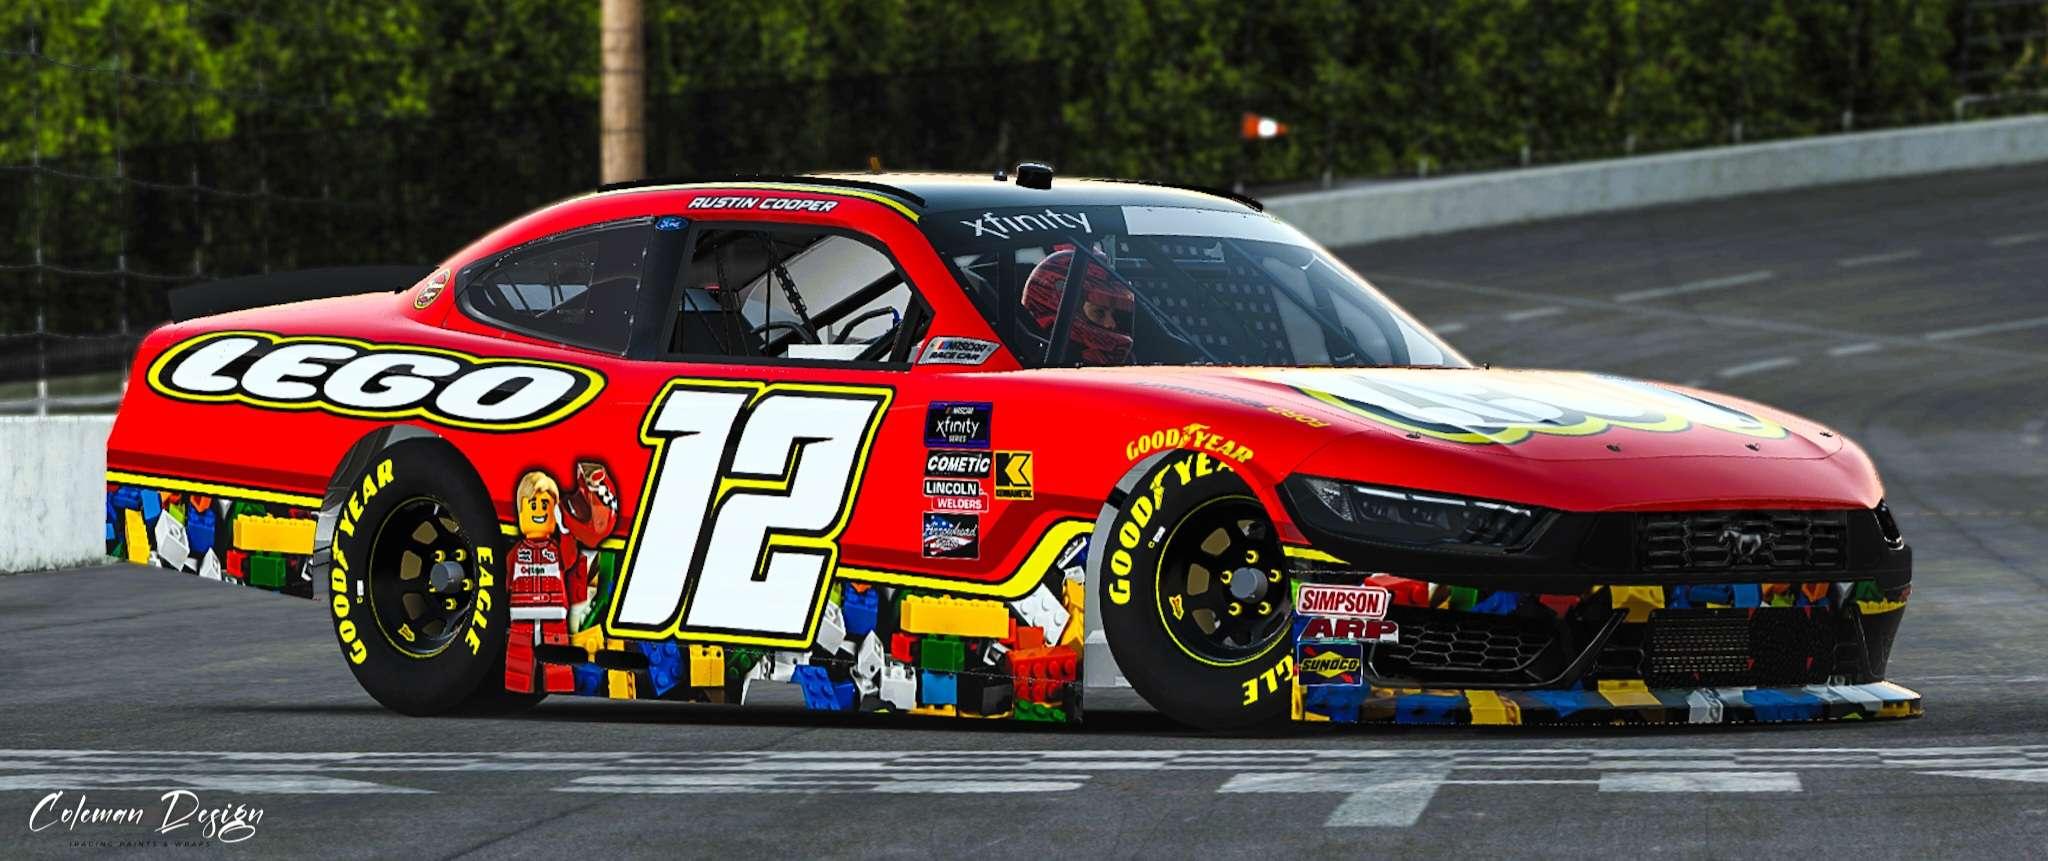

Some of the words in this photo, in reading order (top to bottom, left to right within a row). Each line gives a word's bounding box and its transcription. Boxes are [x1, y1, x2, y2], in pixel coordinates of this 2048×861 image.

[687, 196, 759, 209] AUSTIN
[759, 198, 838, 212] COOPER
[960, 208, 1092, 239] xfinity
[171, 336, 577, 421] LEGO
[936, 416, 980, 439] xfinity
[927, 453, 991, 473] COMETIC
[925, 482, 977, 496] LINCOLN
[614, 385, 882, 637] 12
[937, 498, 982, 509] WELDERS
[331, 459, 395, 664] GOODYEAR
[465, 546, 494, 656] EAGLE
[1302, 590, 1380, 614] SIMPSON
[1300, 618, 1398, 640] ARP
[1301, 658, 1361, 671] SUNOCO
